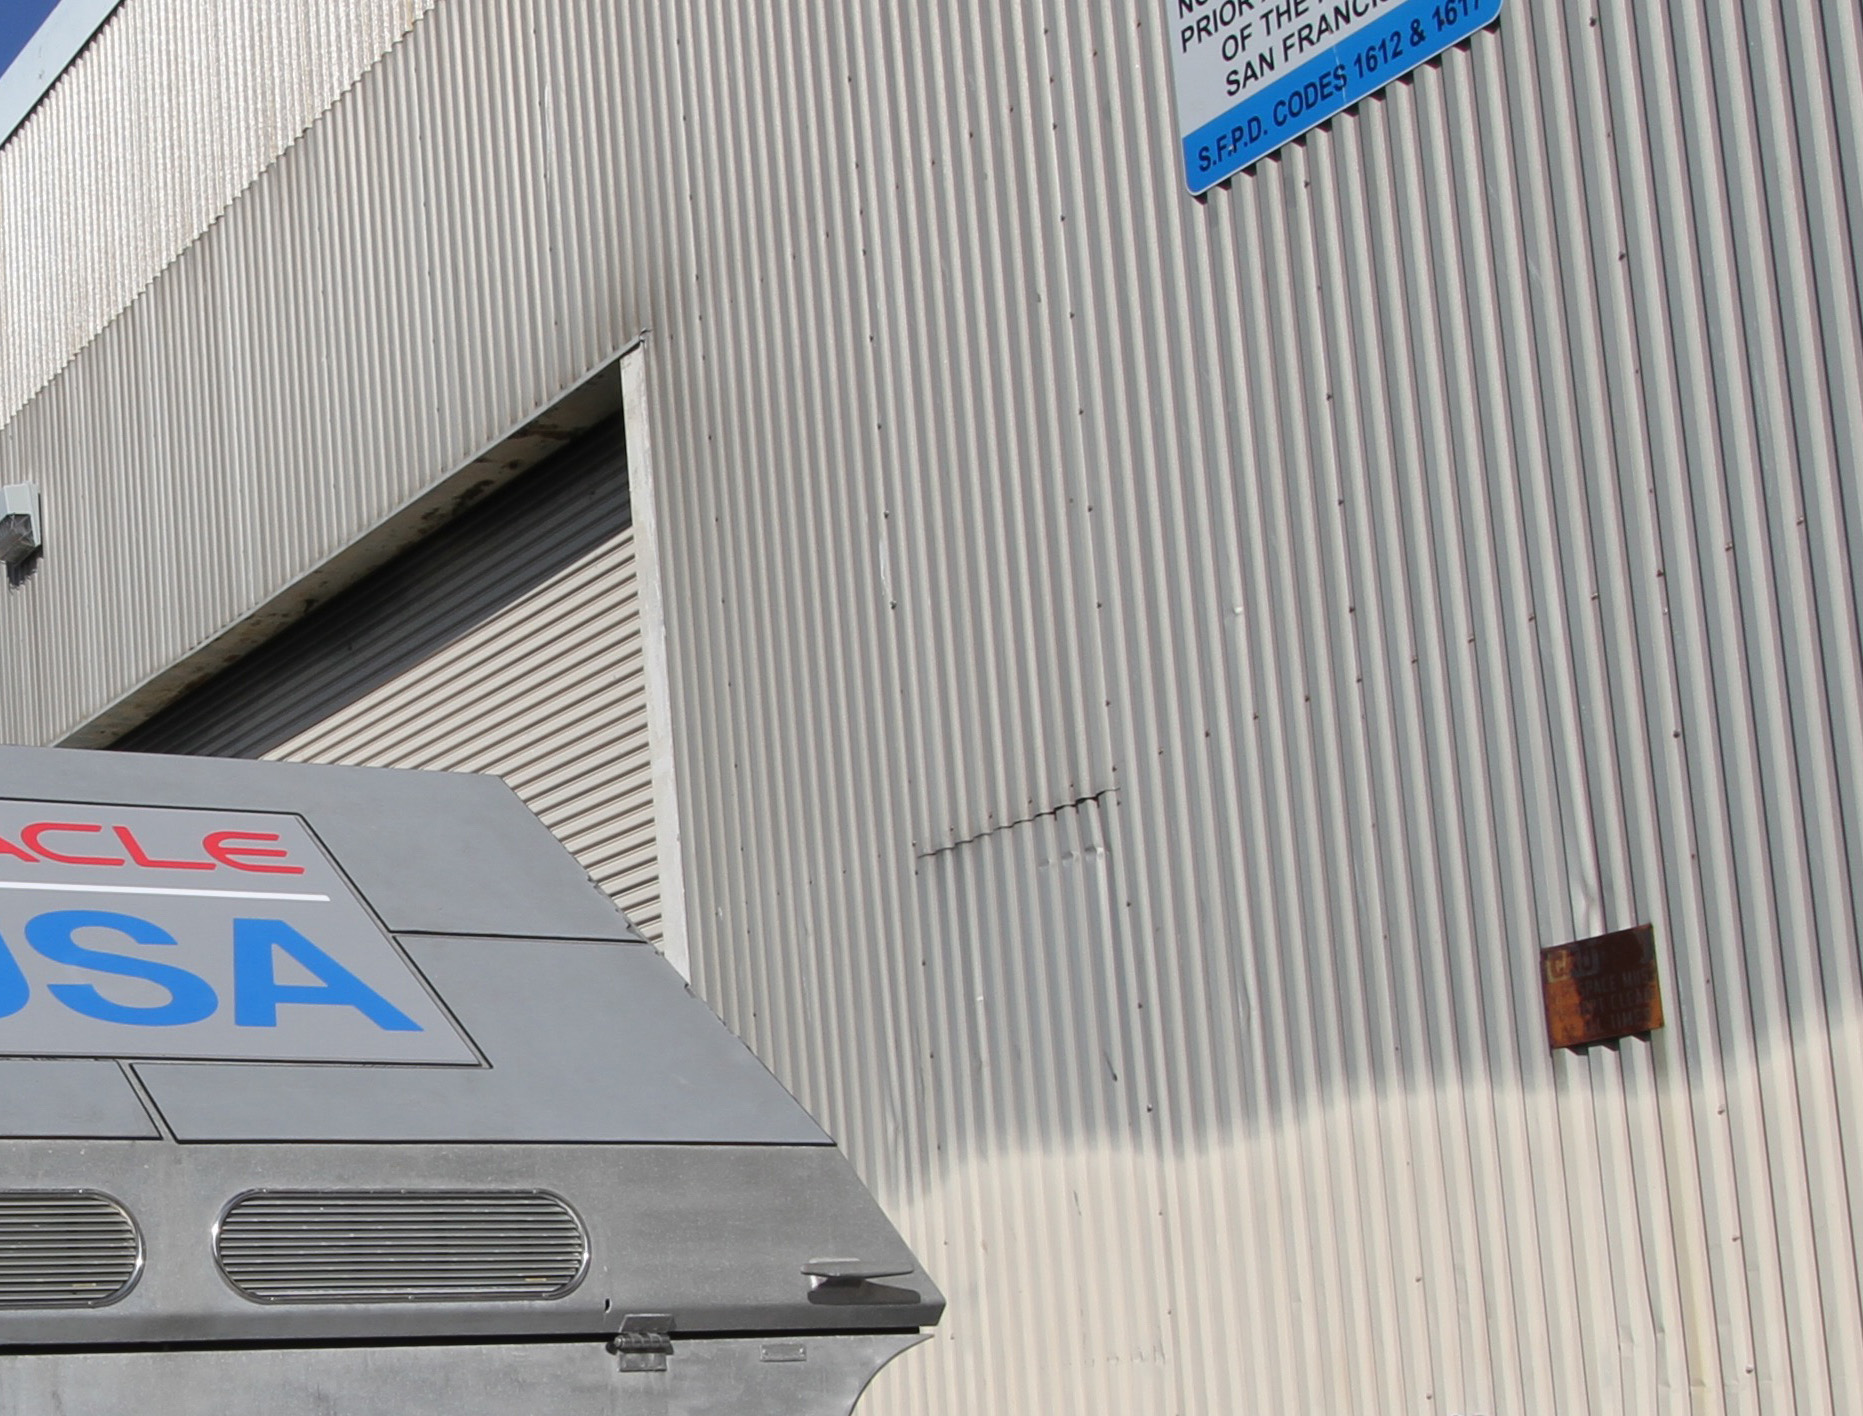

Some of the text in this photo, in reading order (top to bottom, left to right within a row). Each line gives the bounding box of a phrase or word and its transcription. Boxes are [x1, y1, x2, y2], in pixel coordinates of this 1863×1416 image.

[1180, 0, 1254, 53] PRIOR
[1222, 0, 1310, 62] OF THE
[1198, 115, 1268, 172] S.F.P.D.
[1272, 63, 1348, 127] CODES
[1353, 30, 1403, 79] 1612
[1409, 18, 1426, 47] &
[1226, 47, 1275, 97] SAN
